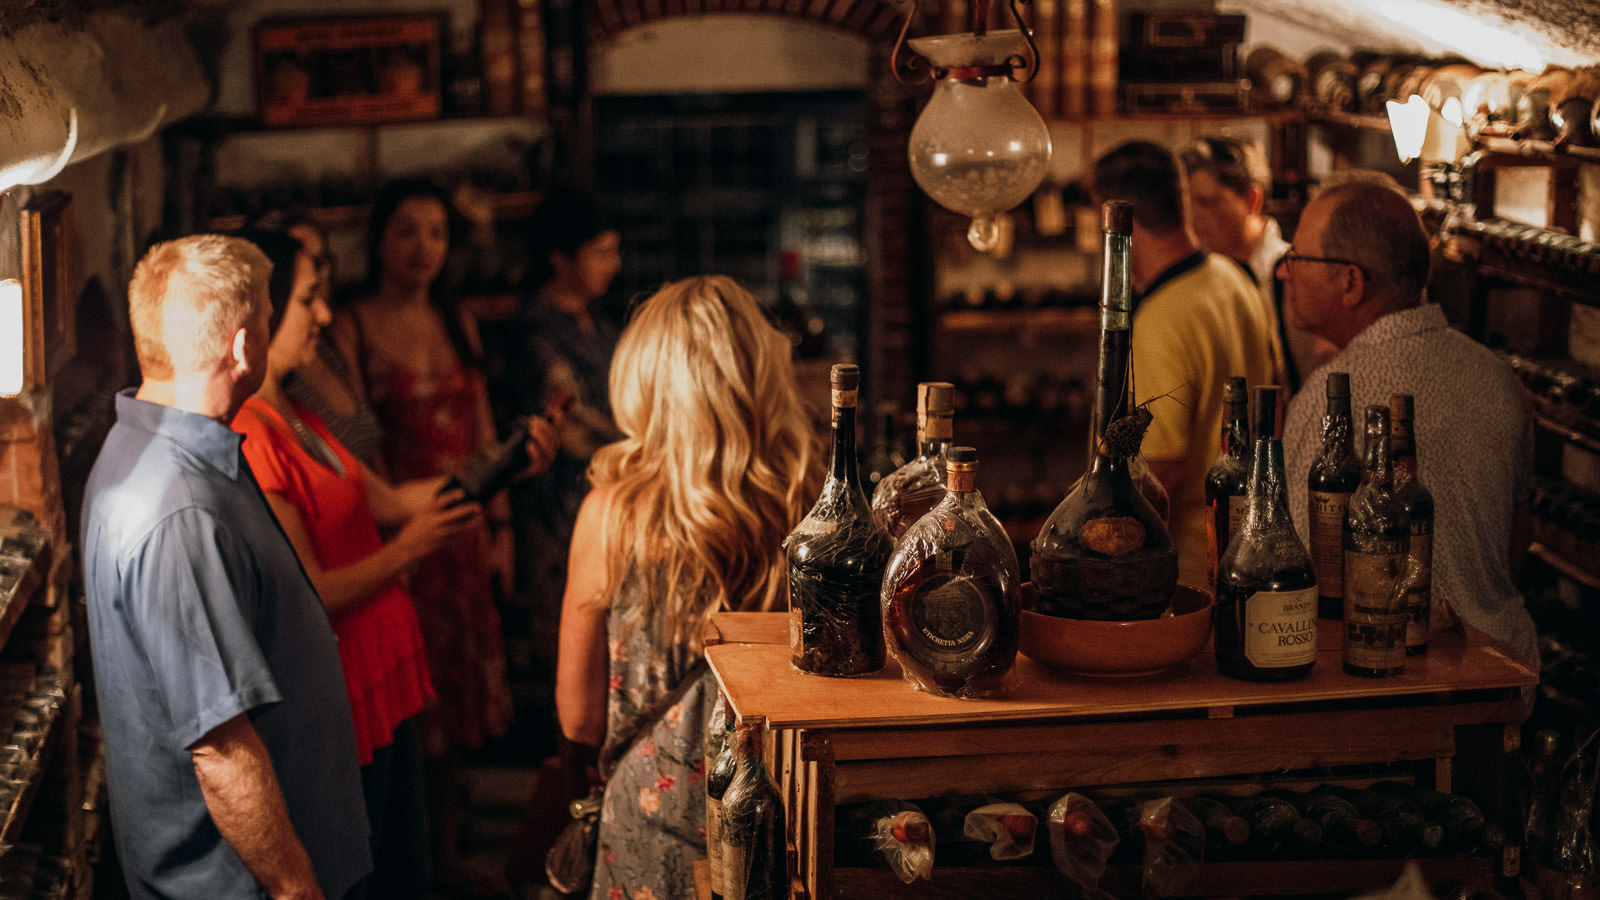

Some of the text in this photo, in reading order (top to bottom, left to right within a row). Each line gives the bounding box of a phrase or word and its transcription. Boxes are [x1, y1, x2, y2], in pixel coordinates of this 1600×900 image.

[1283, 600, 1312, 612] BRANDY
[922, 627, 975, 647] ETICHETTA NERA
[1278, 631, 1313, 647] ROSSO
